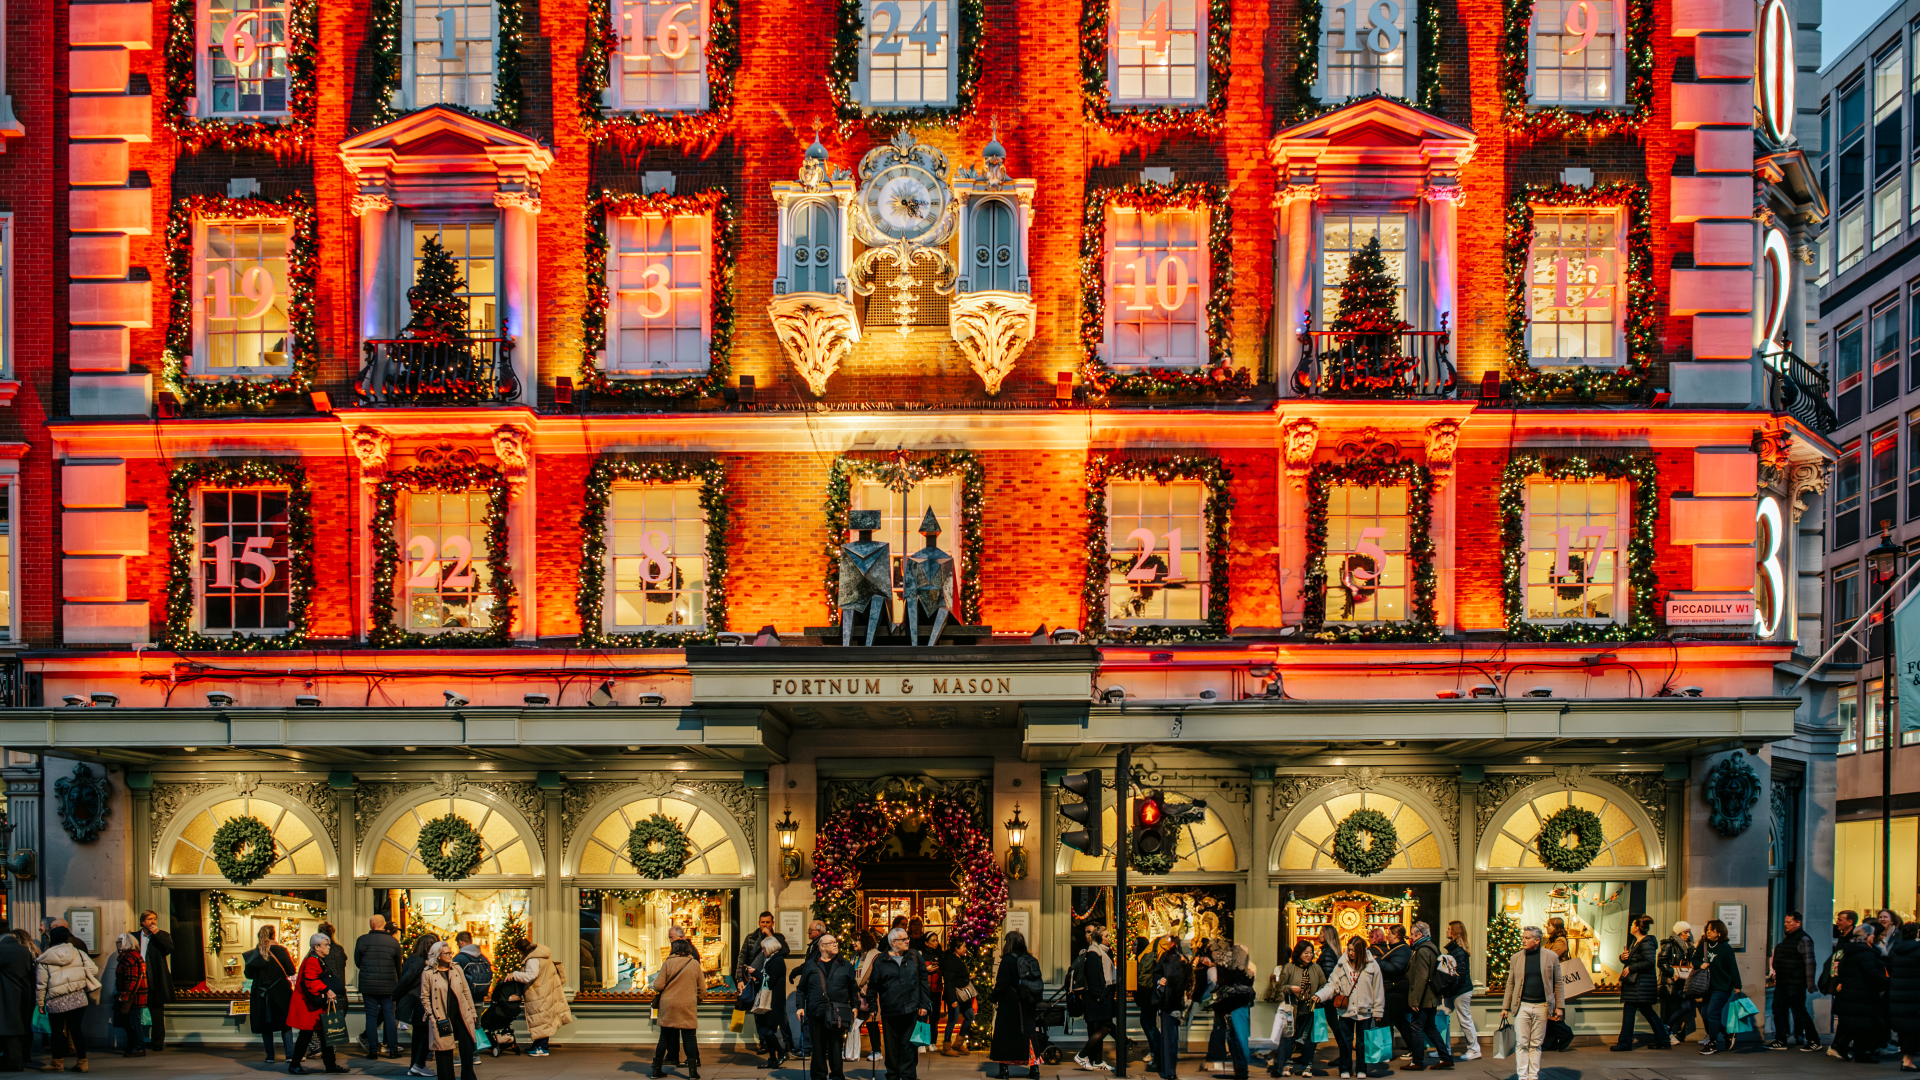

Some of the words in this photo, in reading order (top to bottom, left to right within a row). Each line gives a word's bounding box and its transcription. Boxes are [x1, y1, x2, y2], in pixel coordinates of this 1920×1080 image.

[222, 12, 258, 67] 6
[434, 8, 463, 62] 1
[623, 2, 694, 61] 16
[872, 1, 942, 56] 24
[1137, 1, 1170, 56] 4
[1335, 0, 1401, 55] 18
[1563, 1, 1599, 55] 9
[207, 266, 277, 321] 19
[637, 263, 671, 319] 3
[1126, 255, 1189, 312] 10
[1546, 256, 1611, 312] 12
[208, 536, 276, 589] 15
[406, 535, 476, 588] 22
[639, 530, 672, 584] 8
[1126, 527, 1187, 582] 21
[1352, 526, 1387, 580] 5
[1551, 526, 1609, 578] 17
[1672, 604, 1732, 614] PICCADILLY
[1735, 604, 1749, 613] W1
[772, 678, 881, 695] FORTNUM
[901, 678, 914, 694] &
[933, 678, 1011, 694] MASON
[274, 901, 300, 910] LIFT
